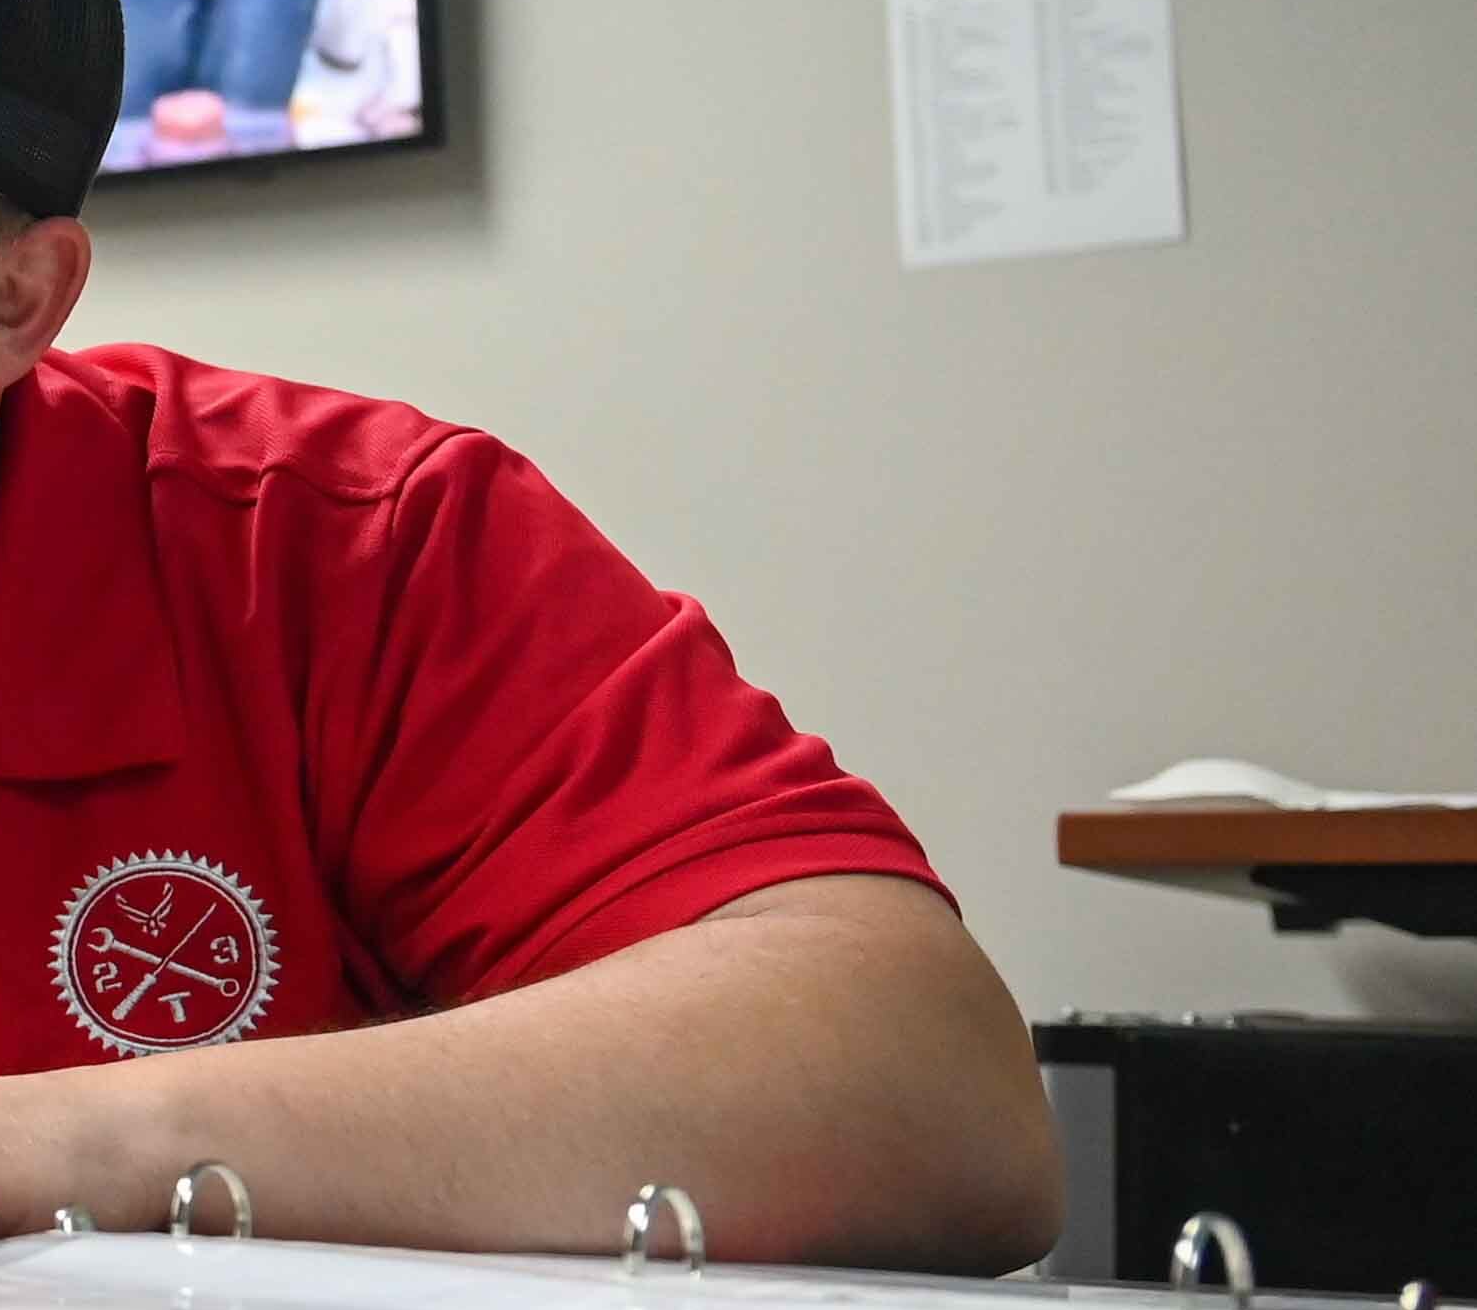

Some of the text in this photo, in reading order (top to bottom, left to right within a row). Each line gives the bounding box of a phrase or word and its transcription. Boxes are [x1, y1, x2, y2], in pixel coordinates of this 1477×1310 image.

[93, 935, 239, 1023] 2 T 3
